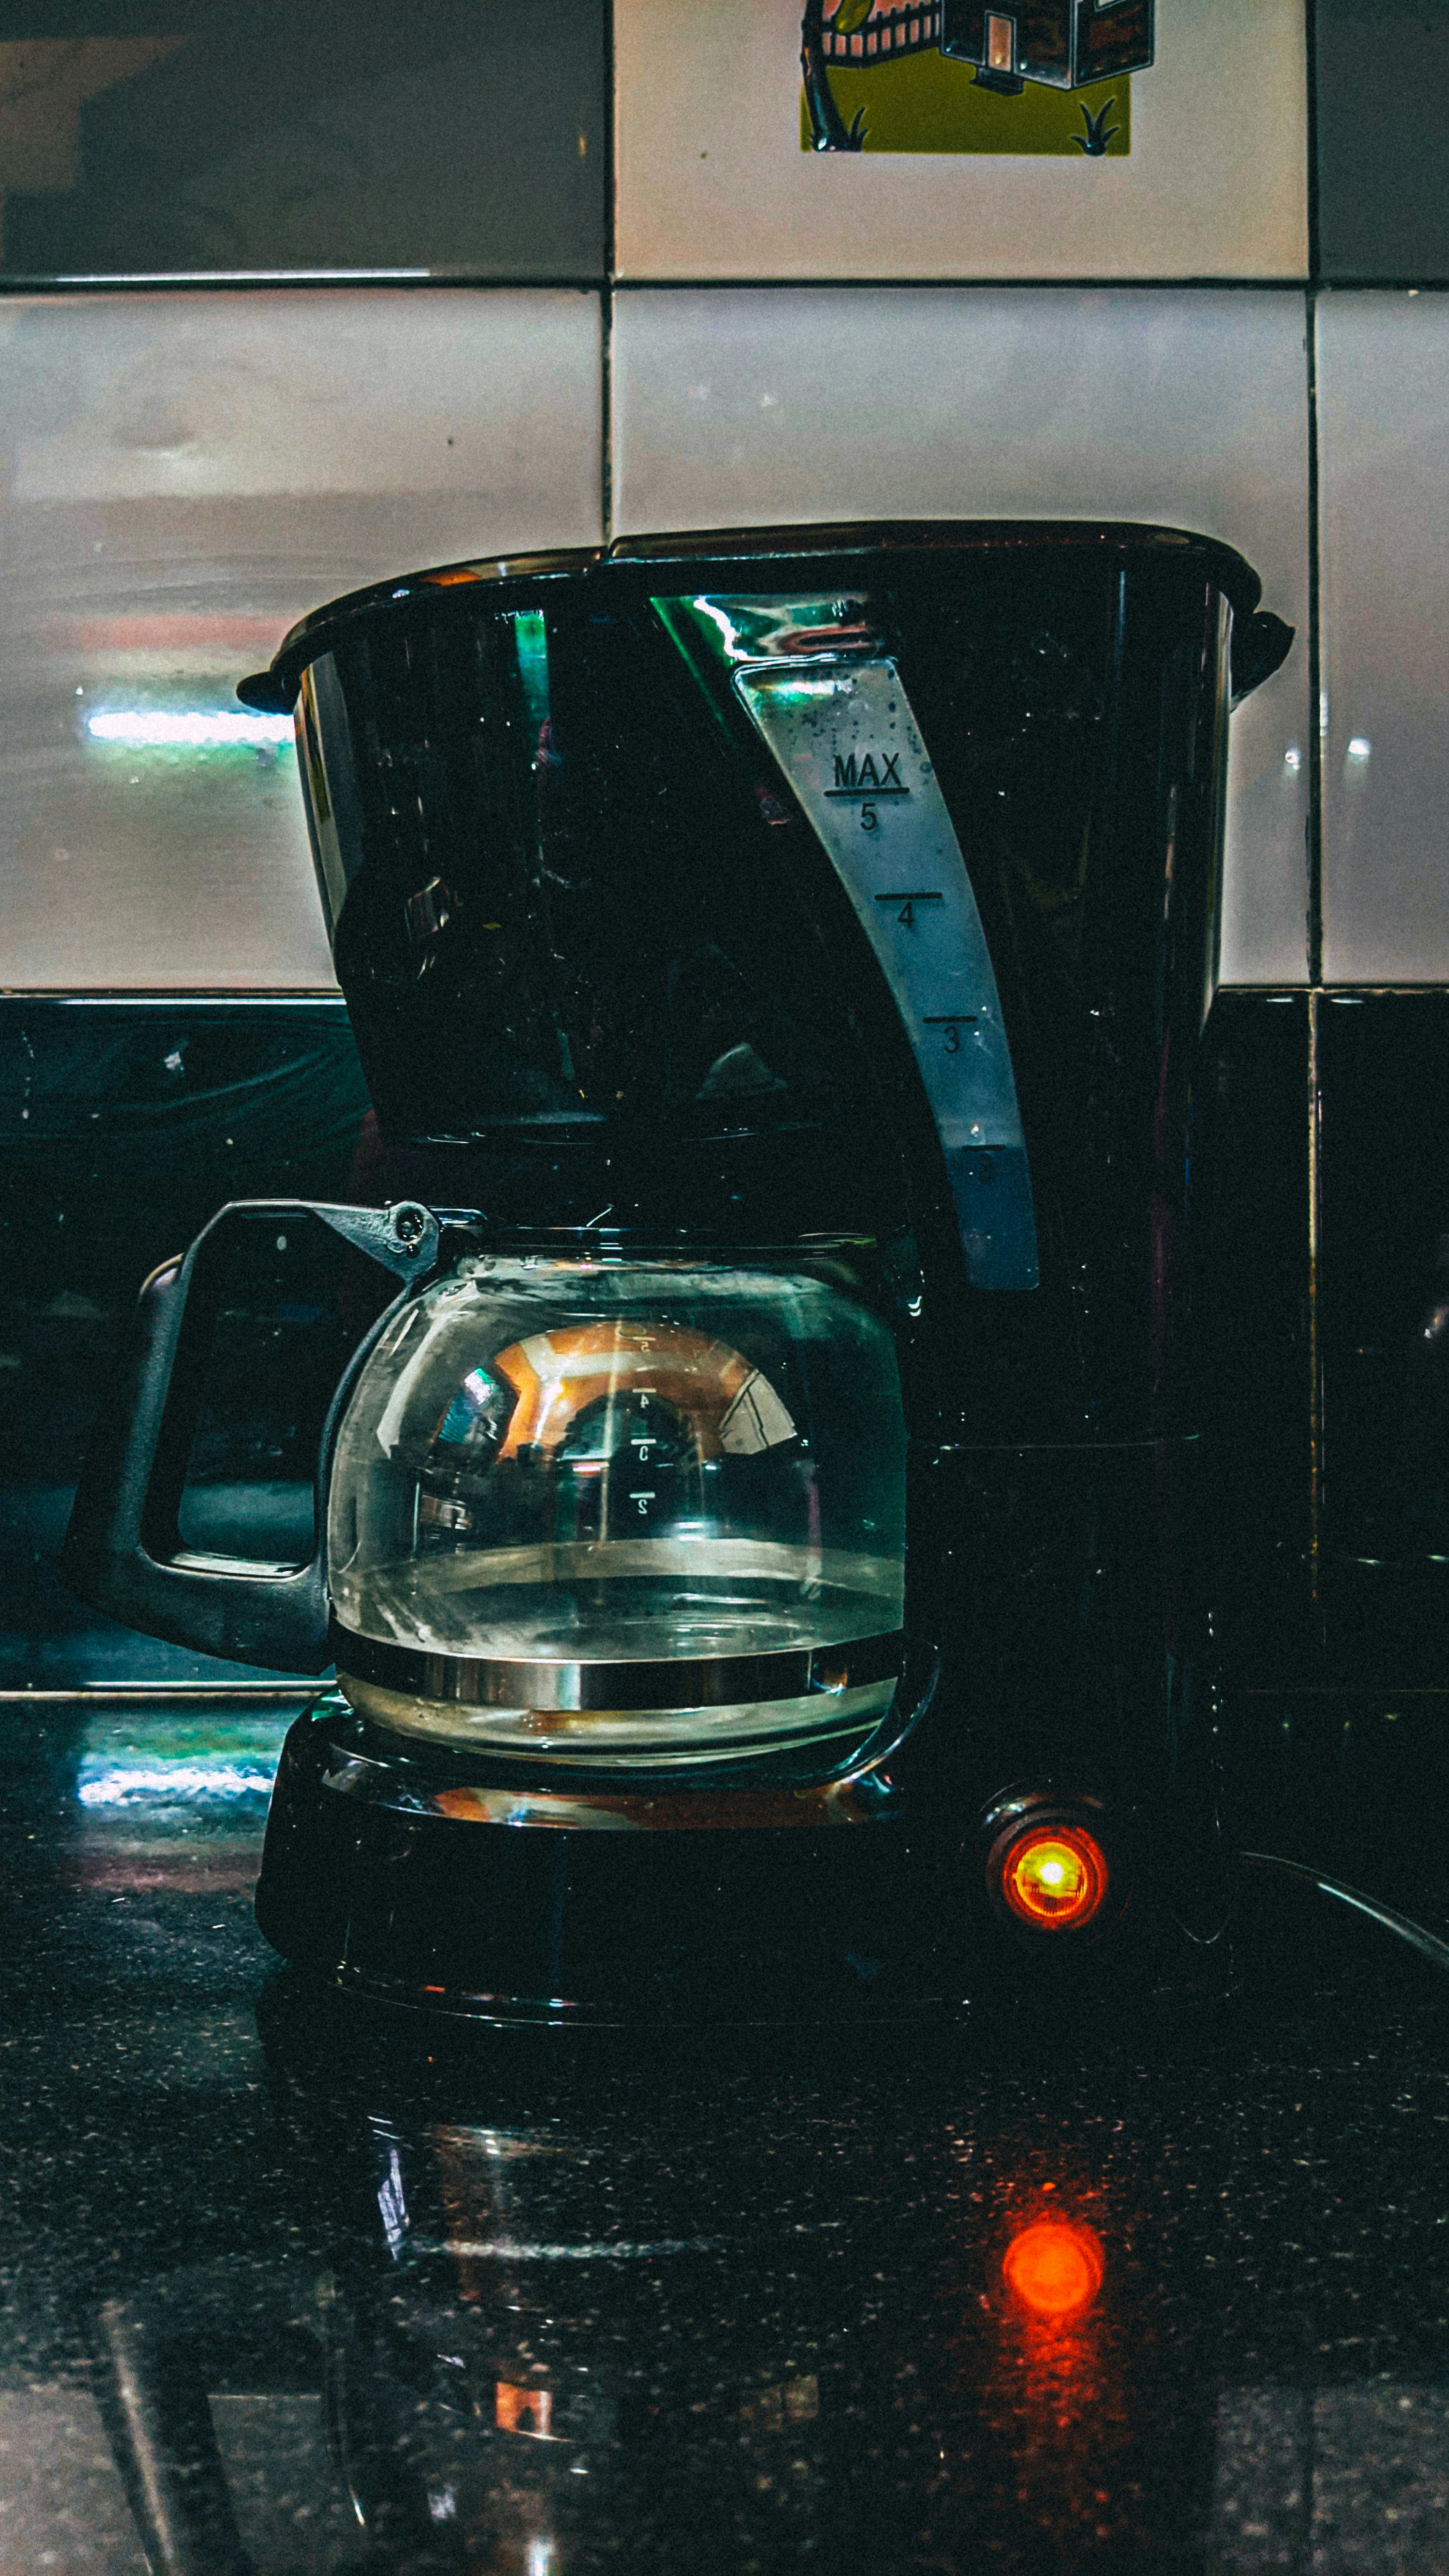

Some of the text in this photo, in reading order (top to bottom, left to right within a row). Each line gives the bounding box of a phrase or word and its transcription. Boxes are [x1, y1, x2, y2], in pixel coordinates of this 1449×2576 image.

[835, 753, 901, 787] MAX
[861, 803, 877, 830] 5
[898, 902, 914, 928] 4
[944, 1026, 960, 1053] 3
